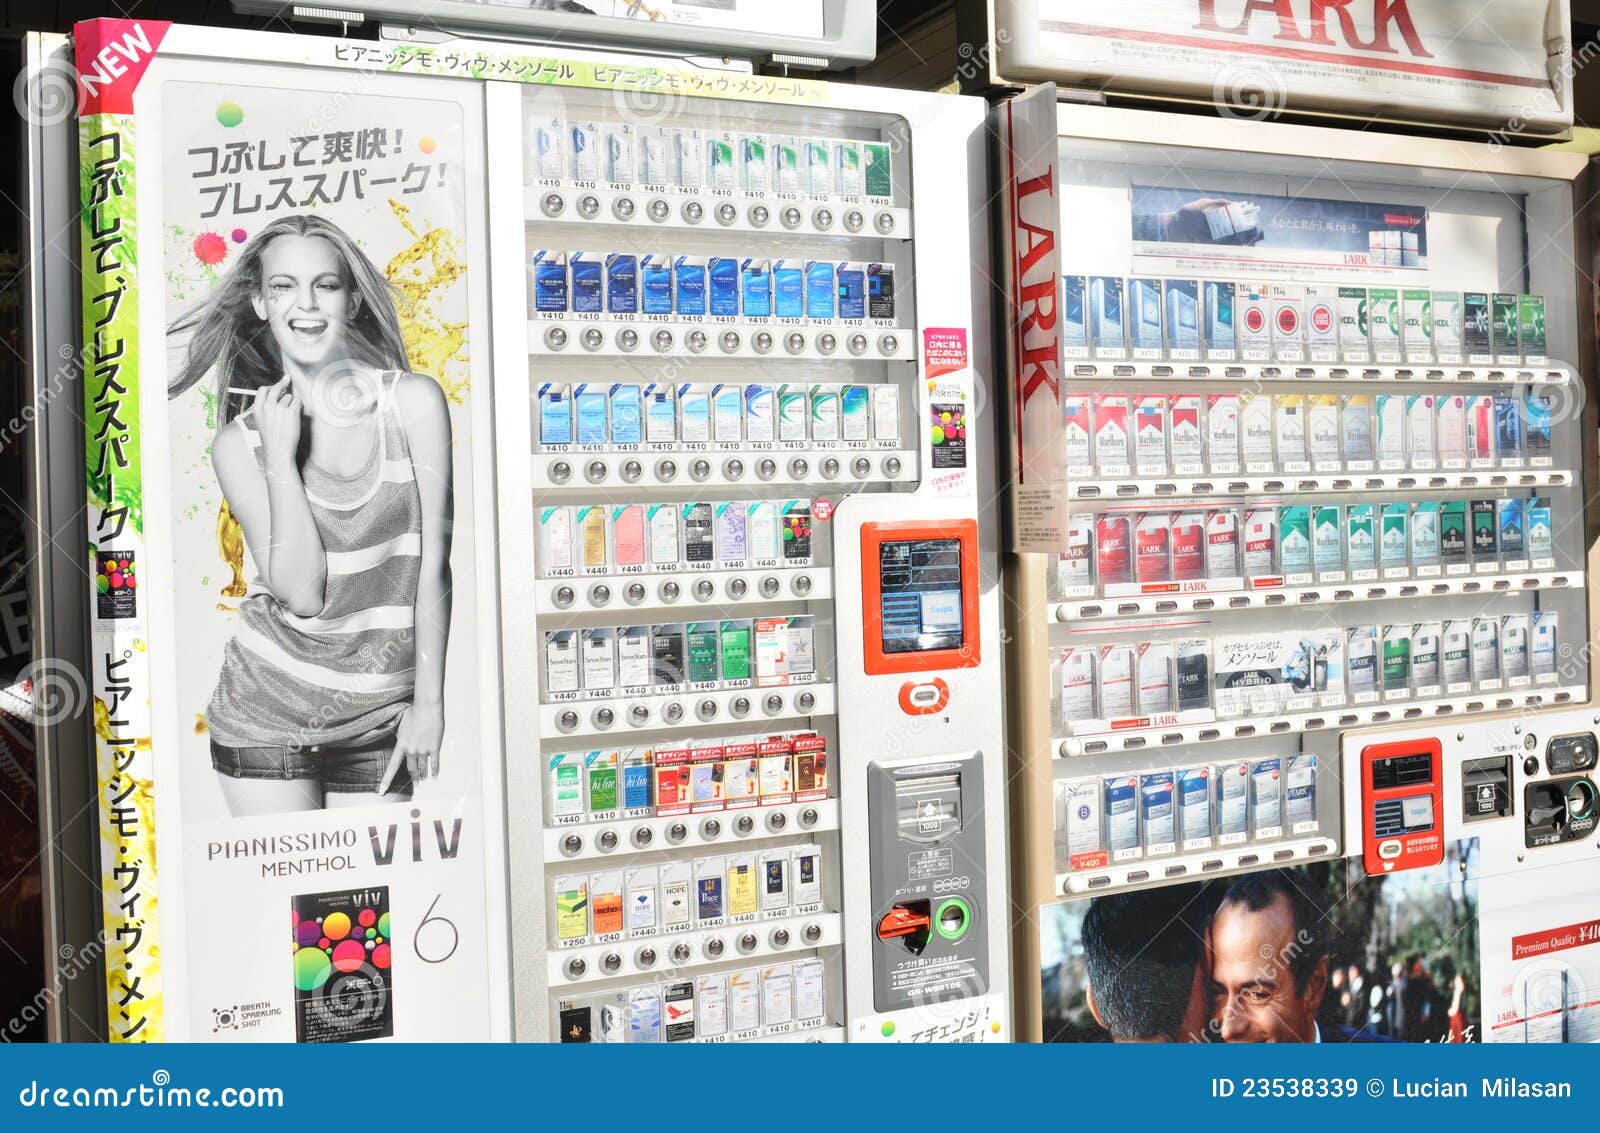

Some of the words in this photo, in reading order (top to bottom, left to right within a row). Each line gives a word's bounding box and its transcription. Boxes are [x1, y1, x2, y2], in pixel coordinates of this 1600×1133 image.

[79, 22, 155, 98] NEW
[333, 43, 576, 81] ピアニッシモ・ヴィヴ・メンソール
[575, 181, 596, 189] ¥410
[609, 183, 631, 191] ¥410
[644, 185, 665, 193] ¥410
[678, 187, 699, 195] ¥410
[1343, 254, 1368, 265] LARK
[1016, 163, 1061, 413] LARK
[542, 312, 564, 320] ¥410
[546, 444, 568, 452] ¥410
[720, 442, 740, 450] ¥410
[1142, 544, 1161, 554] LARK
[1178, 544, 1195, 553] LARK
[1250, 542, 1266, 551] LARK
[552, 568, 574, 576] ¥440
[1183, 581, 1207, 592] LARK
[1226, 651, 1278, 666] メンソール
[1231, 677, 1272, 686] HYBRID
[625, 687, 646, 695] ¥440
[1153, 715, 1179, 726] LARK
[558, 815, 580, 824] ¥440
[594, 812, 615, 820] ¥410
[367, 808, 463, 866] viv
[207, 828, 358, 861] PIANISSIMO
[261, 856, 358, 878] MENTHOL
[1079, 858, 1100, 867] ¥400
[666, 887, 686, 895] HOPE
[353, 889, 381, 908] viv
[597, 906, 618, 914] echo
[413, 892, 459, 964] 6
[1515, 940, 1549, 955] Premium
[1550, 934, 1577, 948] Quality
[240, 1001, 271, 1013] BREATH
[241, 1008, 282, 1020] SPARKLING
[1497, 1009, 1518, 1023] LARK
[241, 1018, 261, 1029] SHOT
[802, 1018, 821, 1027] ¥410
[770, 1024, 790, 1032] ¥410
[737, 1030, 758, 1039] ¥410
